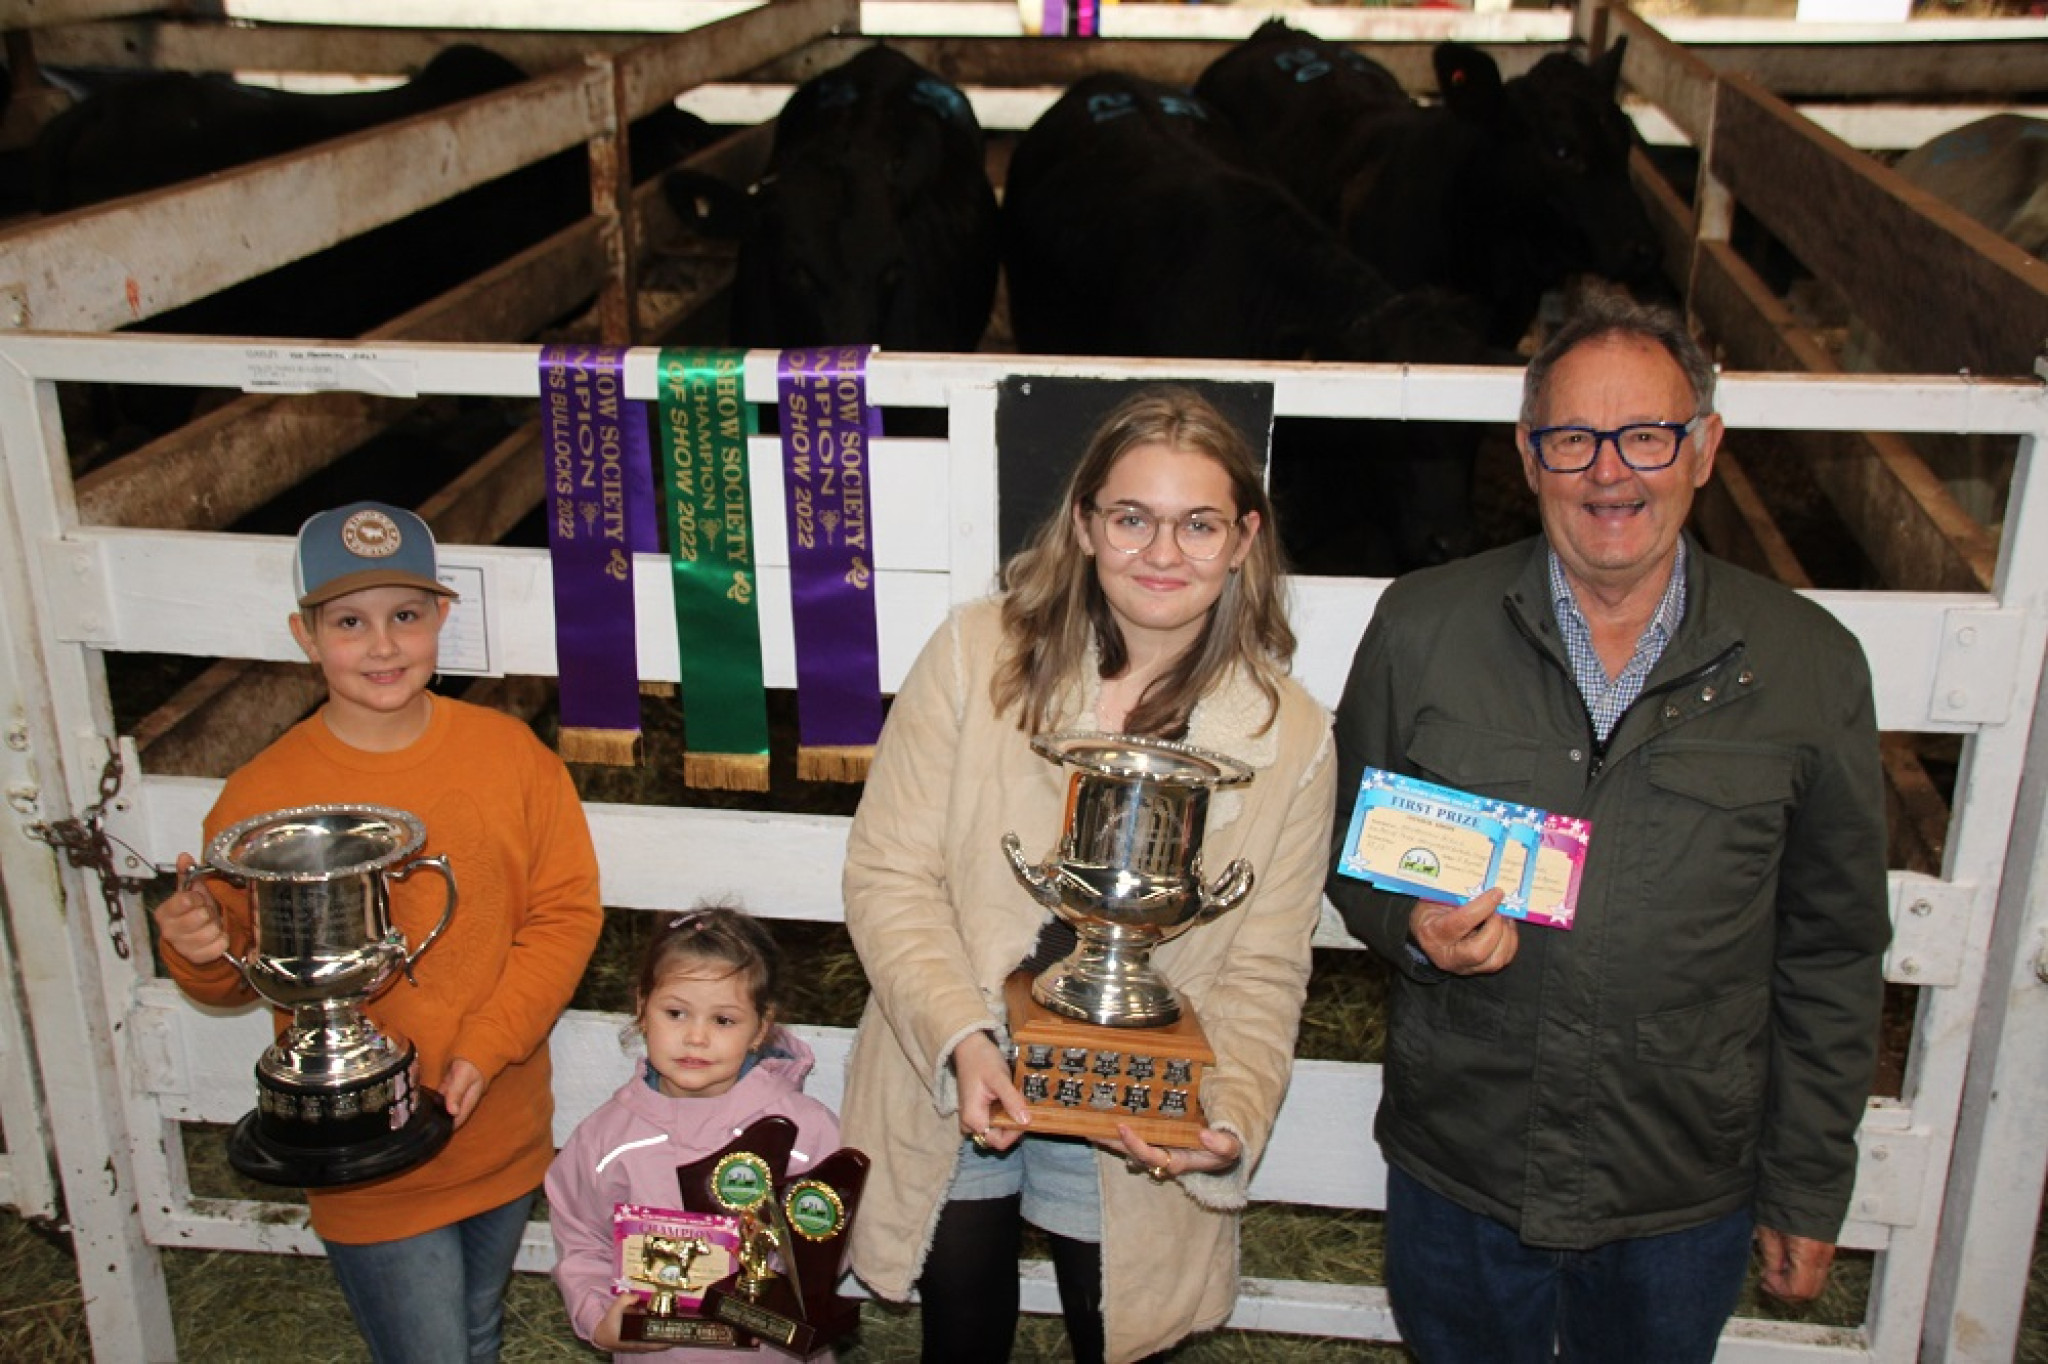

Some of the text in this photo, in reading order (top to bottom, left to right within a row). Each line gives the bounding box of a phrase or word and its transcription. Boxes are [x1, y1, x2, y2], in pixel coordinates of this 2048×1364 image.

[550, 392, 573, 495] BULLOCKS
[599, 425, 625, 543] SOCIETY
[667, 361, 697, 562] OF SHOW 2022
[692, 378, 717, 511] CHAMPION
[716, 359, 749, 564] SHOW SOCIETY
[788, 352, 816, 550] OF SHOW 2022
[837, 349, 866, 550] SHOW SOCIETY
[556, 497, 575, 540] 2022
[1391, 795, 1432, 814] FIRST
[1436, 806, 1481, 828] PRIZE
